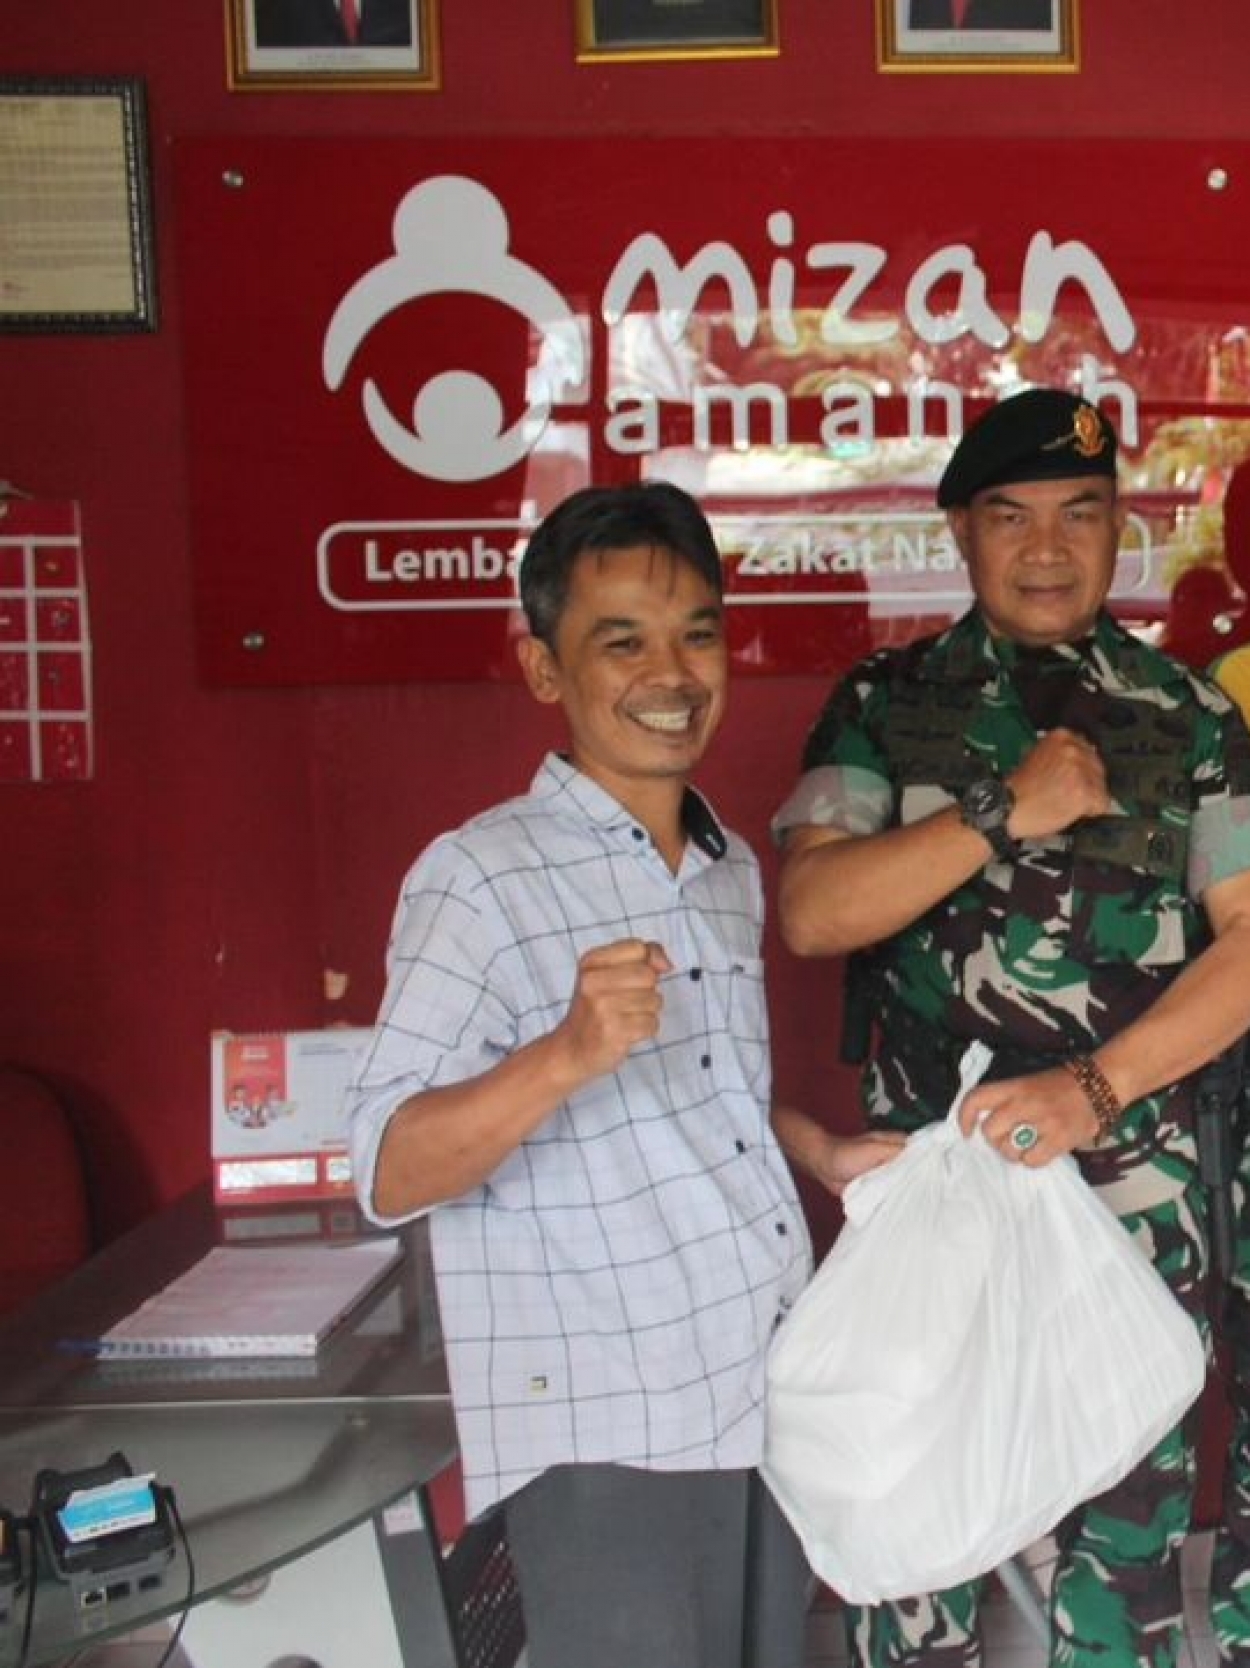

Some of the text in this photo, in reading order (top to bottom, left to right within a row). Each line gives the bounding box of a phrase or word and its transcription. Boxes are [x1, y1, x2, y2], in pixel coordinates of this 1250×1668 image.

[602, 210, 1137, 355] mizan
[603, 353, 1138, 456] amanh
[737, 532, 884, 575] Zakat
